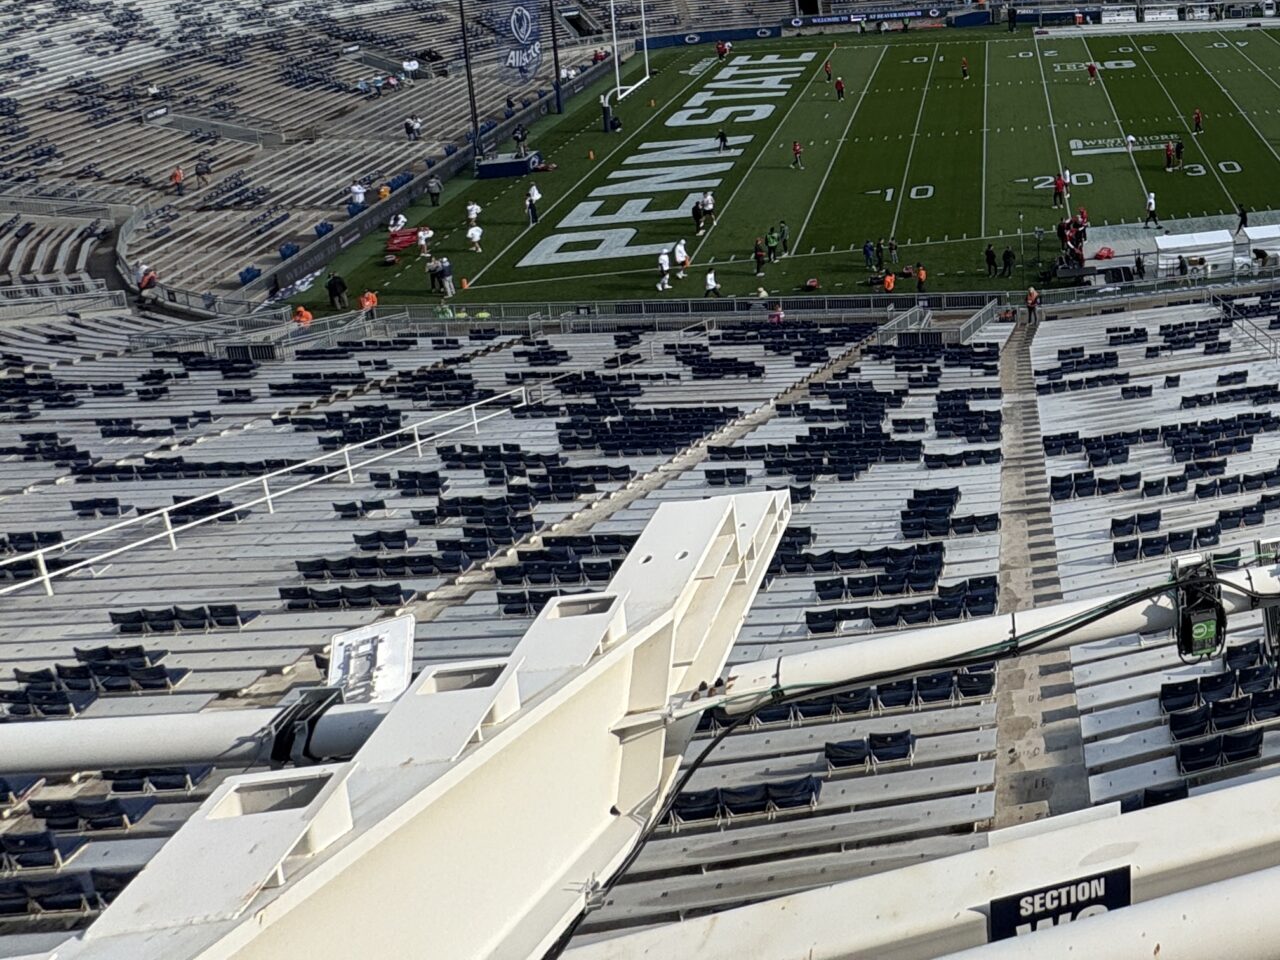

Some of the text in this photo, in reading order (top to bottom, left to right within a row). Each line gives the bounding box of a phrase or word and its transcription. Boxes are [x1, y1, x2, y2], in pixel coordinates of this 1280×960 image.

[515, 51, 818, 268] PENN STATE
[1183, 159, 1243, 177] 30
[882, 184, 935, 202] 10
[1019, 877, 1106, 917] SECTION
